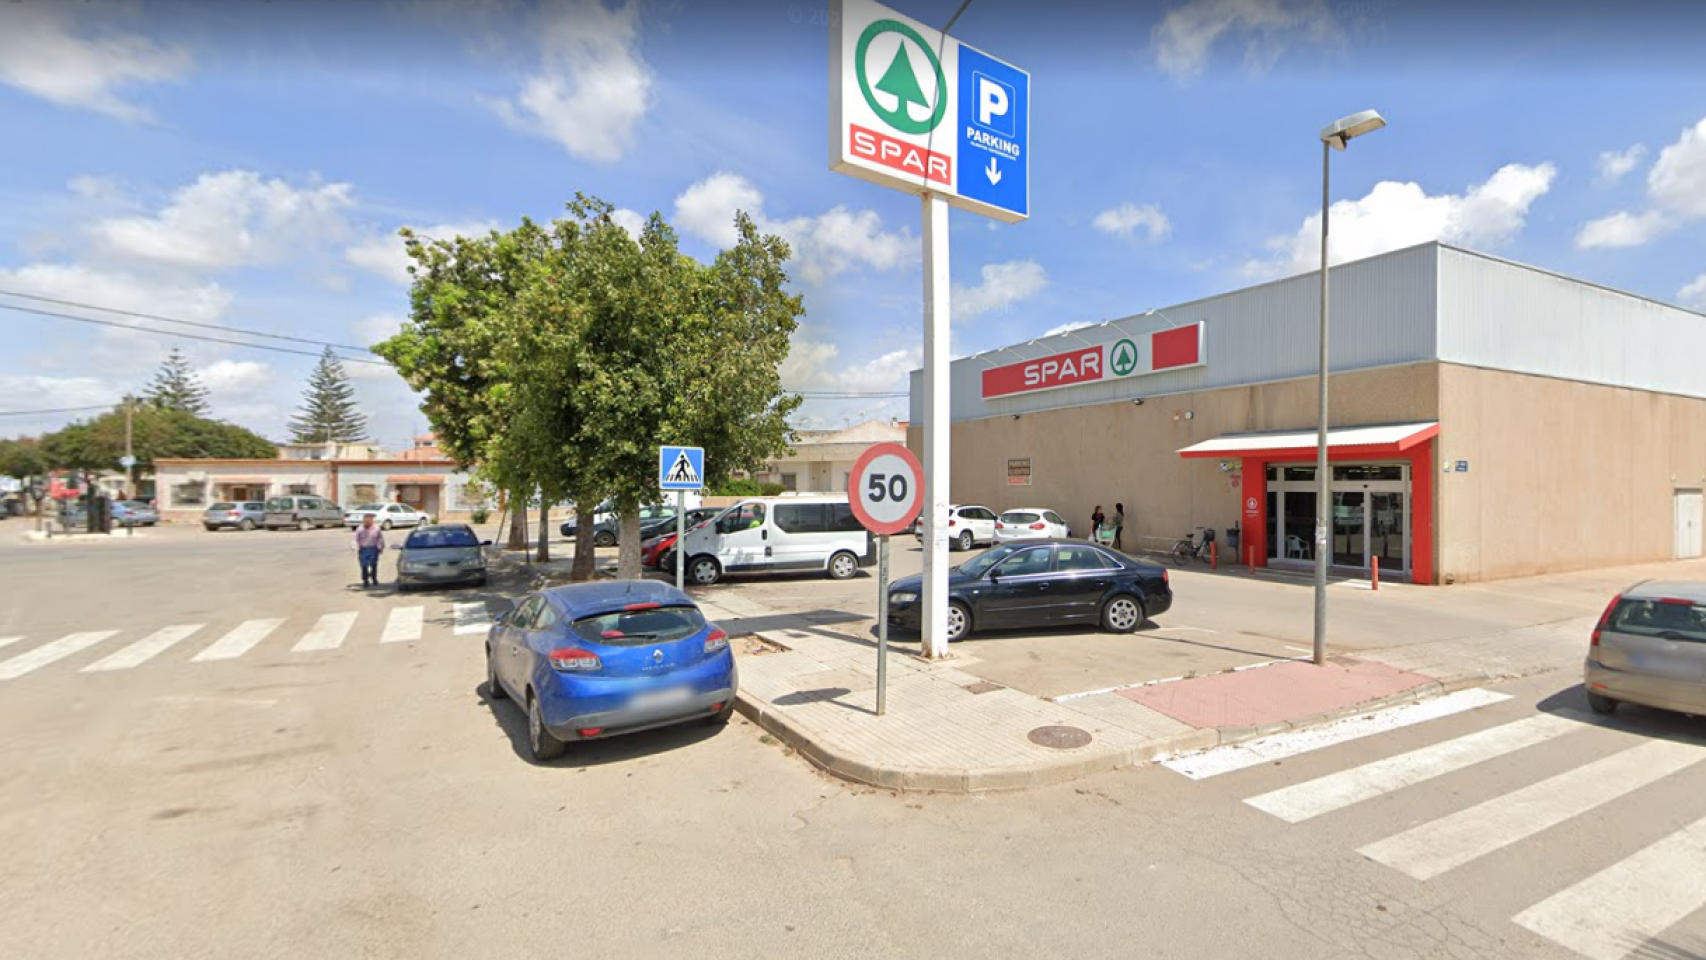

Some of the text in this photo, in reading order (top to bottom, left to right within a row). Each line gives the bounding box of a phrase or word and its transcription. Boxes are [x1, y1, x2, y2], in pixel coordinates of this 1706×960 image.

[979, 77, 1009, 126] P
[855, 131, 948, 179] SPAR
[966, 126, 1020, 157] PARKING
[1024, 352, 1100, 386] SPAR
[868, 474, 908, 502] 50
